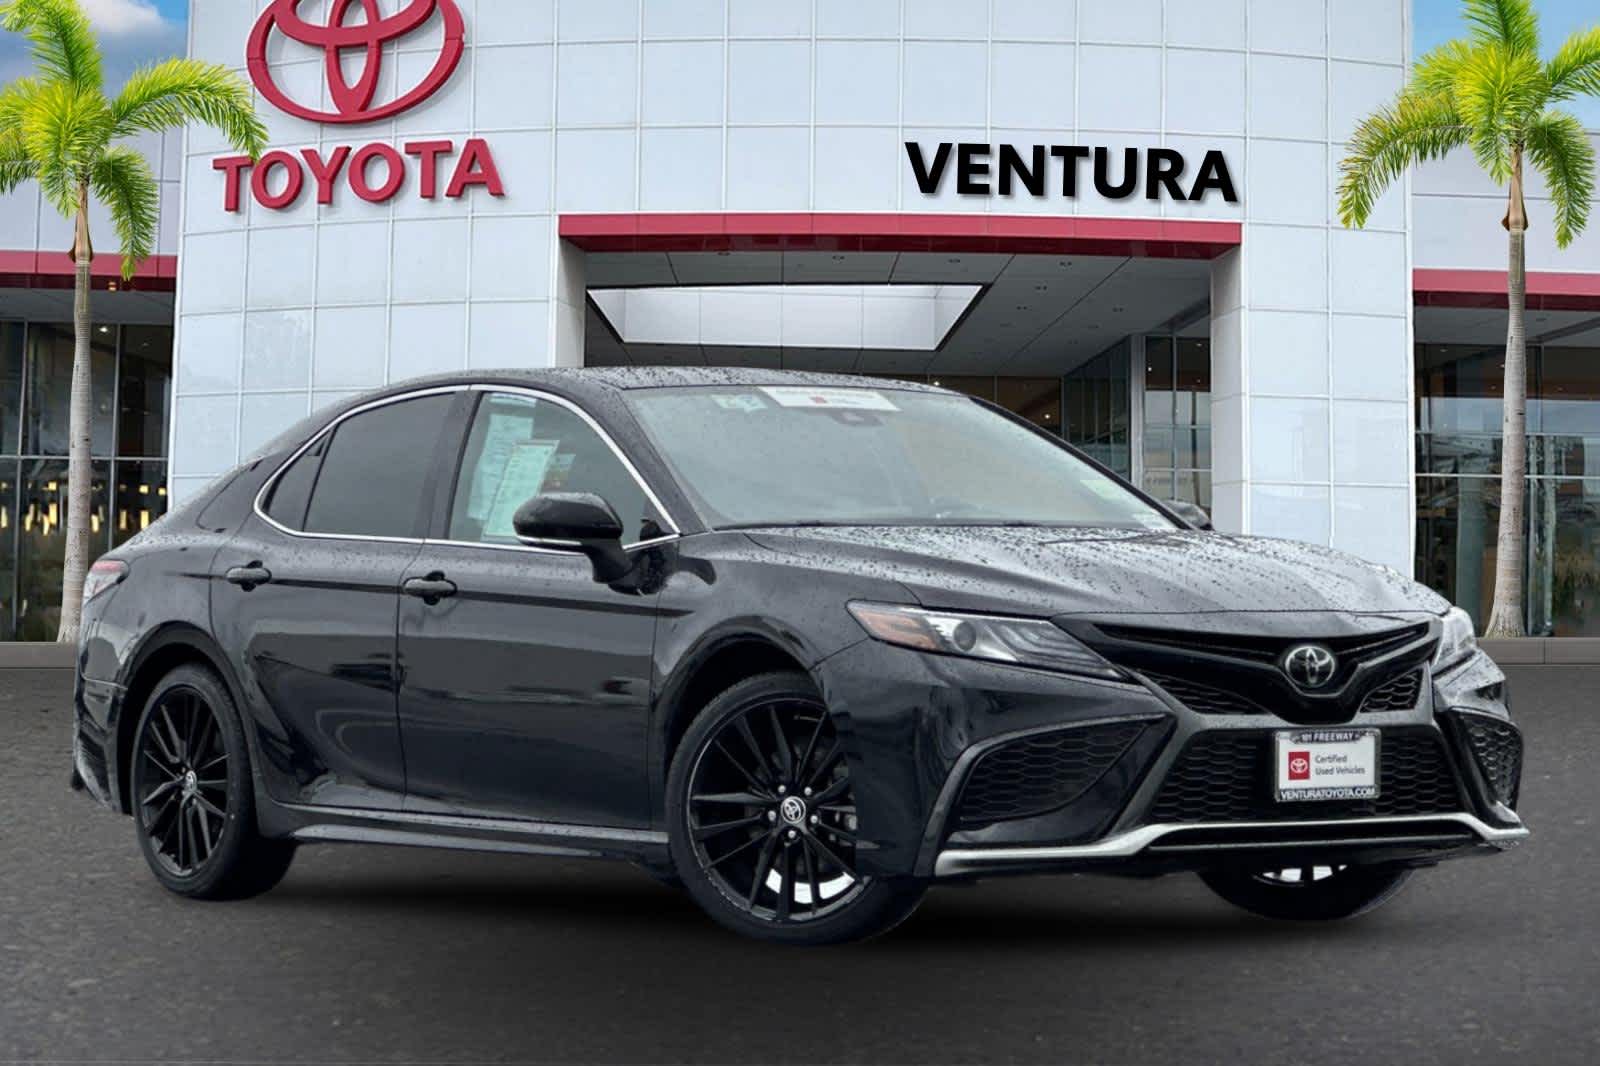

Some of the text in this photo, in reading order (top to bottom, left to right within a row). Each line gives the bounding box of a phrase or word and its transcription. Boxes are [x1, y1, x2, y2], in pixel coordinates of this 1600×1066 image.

[212, 138, 505, 212] TOYOTA
[904, 142, 1239, 203] VENTURA
[1313, 731, 1353, 742] FREEWAY
[1315, 754, 1348, 763] Certified
[1315, 765, 1365, 776] Used Vehicles
[1280, 787, 1375, 800] VENTURATOYOTA.COM
